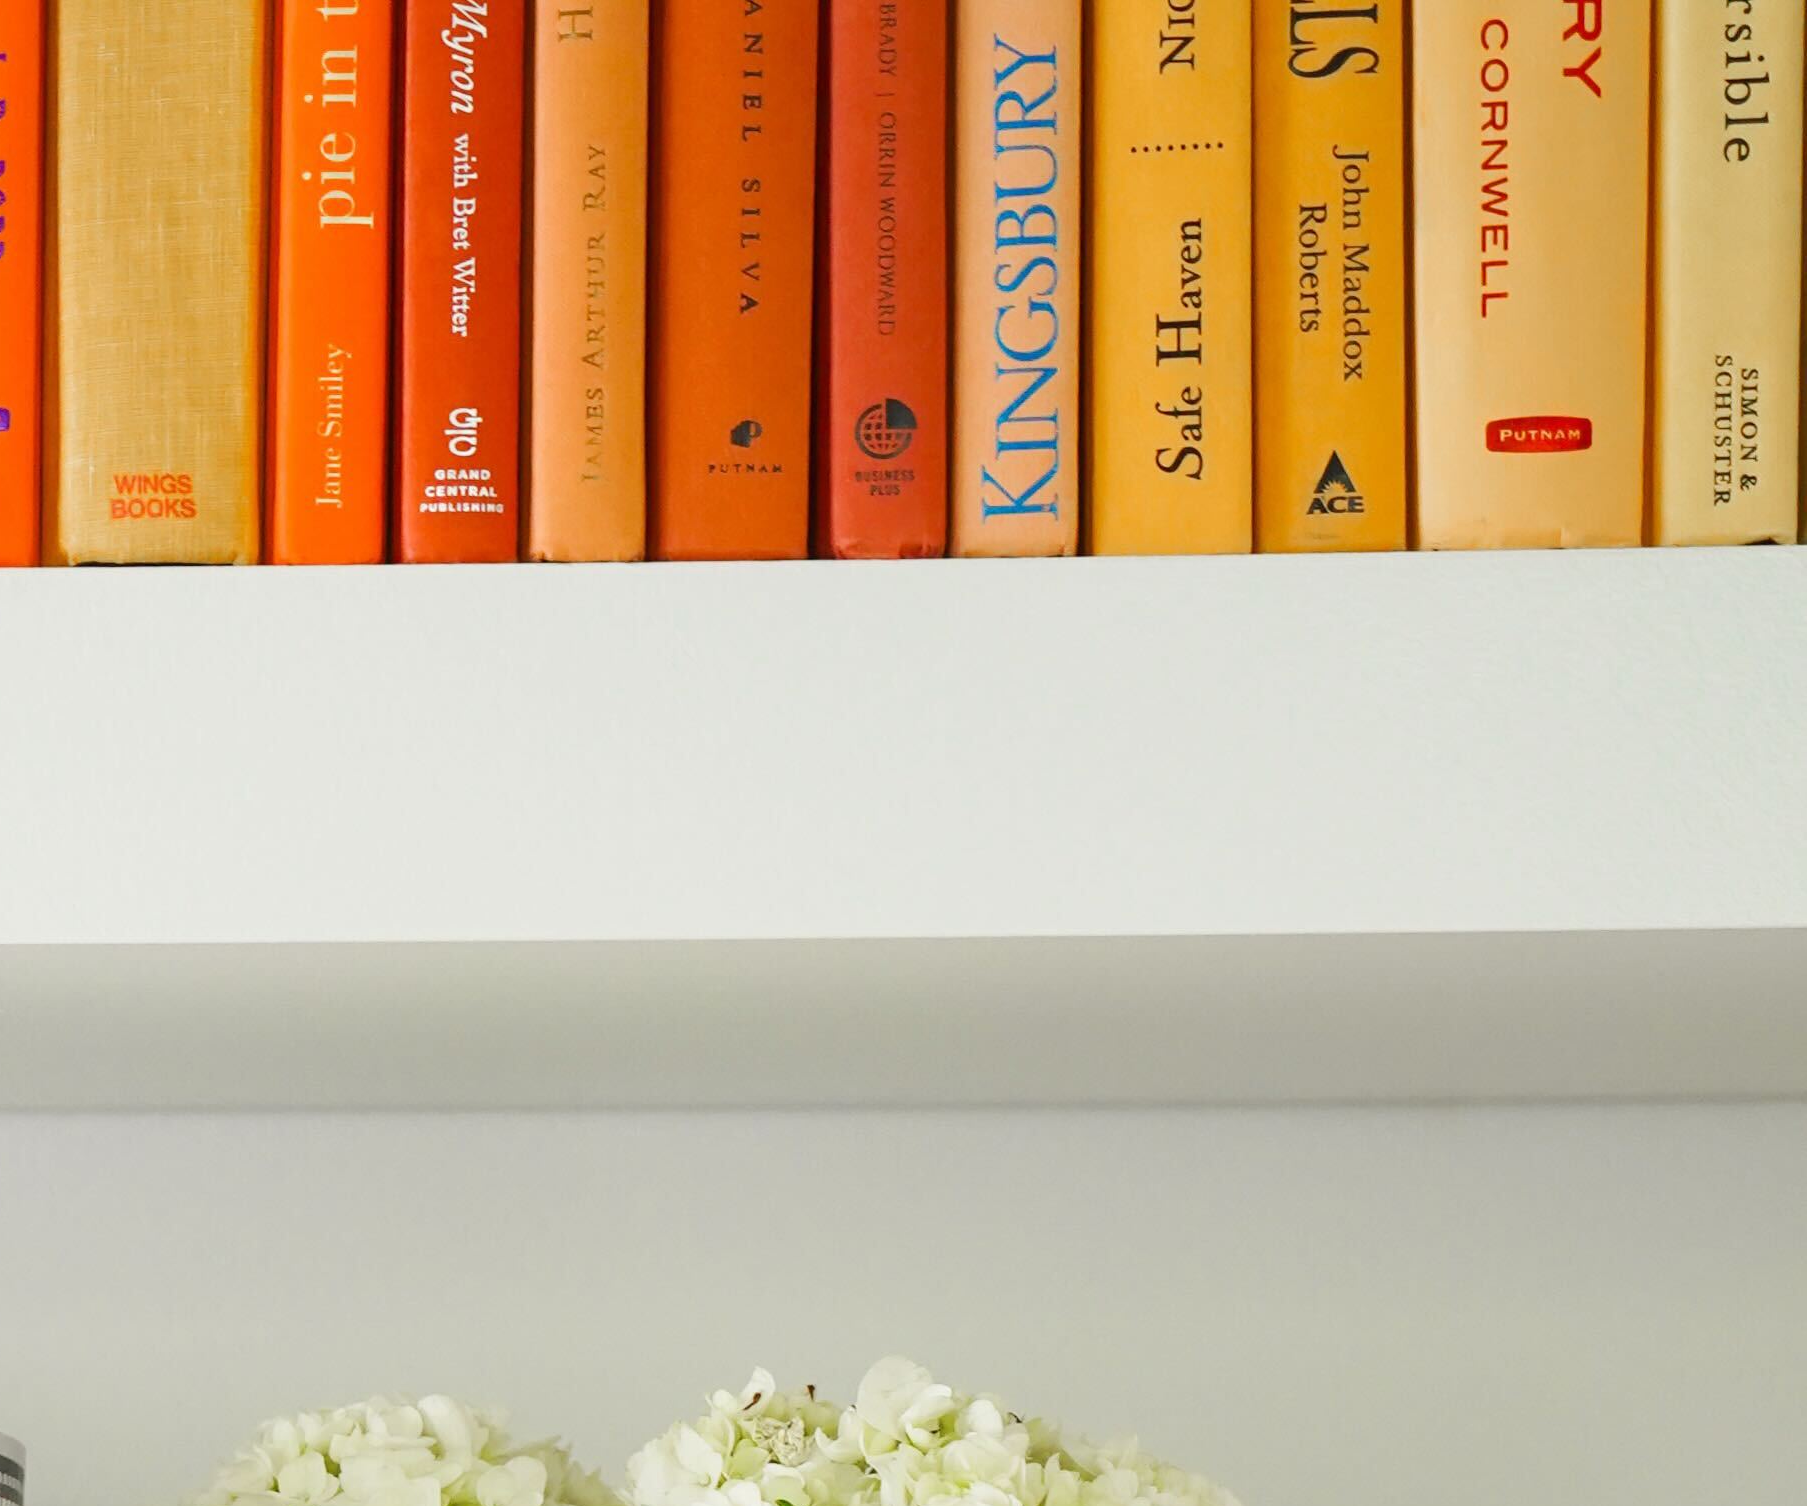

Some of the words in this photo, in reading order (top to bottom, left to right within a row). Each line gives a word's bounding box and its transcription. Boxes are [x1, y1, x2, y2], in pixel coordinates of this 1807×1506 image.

[303, 44, 358, 108] in
[302, 130, 375, 230] pie
[452, 132, 479, 189] with
[581, 144, 608, 213] RAY
[1333, 143, 1371, 231] John
[1480, 19, 1510, 319] CORNWELL
[451, 196, 478, 251] Bret
[738, 177, 762, 315] SILVA
[450, 255, 477, 338] Witter
[877, 195, 898, 338] WOODWARD
[979, 32, 1061, 525] KINGSBURY
[1155, 217, 1204, 367] Haven
[1297, 202, 1329, 334] Roberts
[1343, 242, 1371, 382] Maddox
[316, 343, 354, 440] Smiley
[1714, 354, 1733, 507] SCHUSTER
[1740, 368, 1760, 463] SIMON
[1155, 386, 1204, 481] Safe
[1498, 428, 1581, 443] PUTNAM
[110, 497, 199, 521] BOOKS
[113, 473, 193, 497] WINGS
[315, 446, 344, 509] Jane
[424, 483, 499, 499] CENTRAL
[433, 468, 492, 483] GRAND
[869, 482, 901, 497] PLUS
[1306, 496, 1365, 516] ACE
[1740, 473, 1759, 492] &
